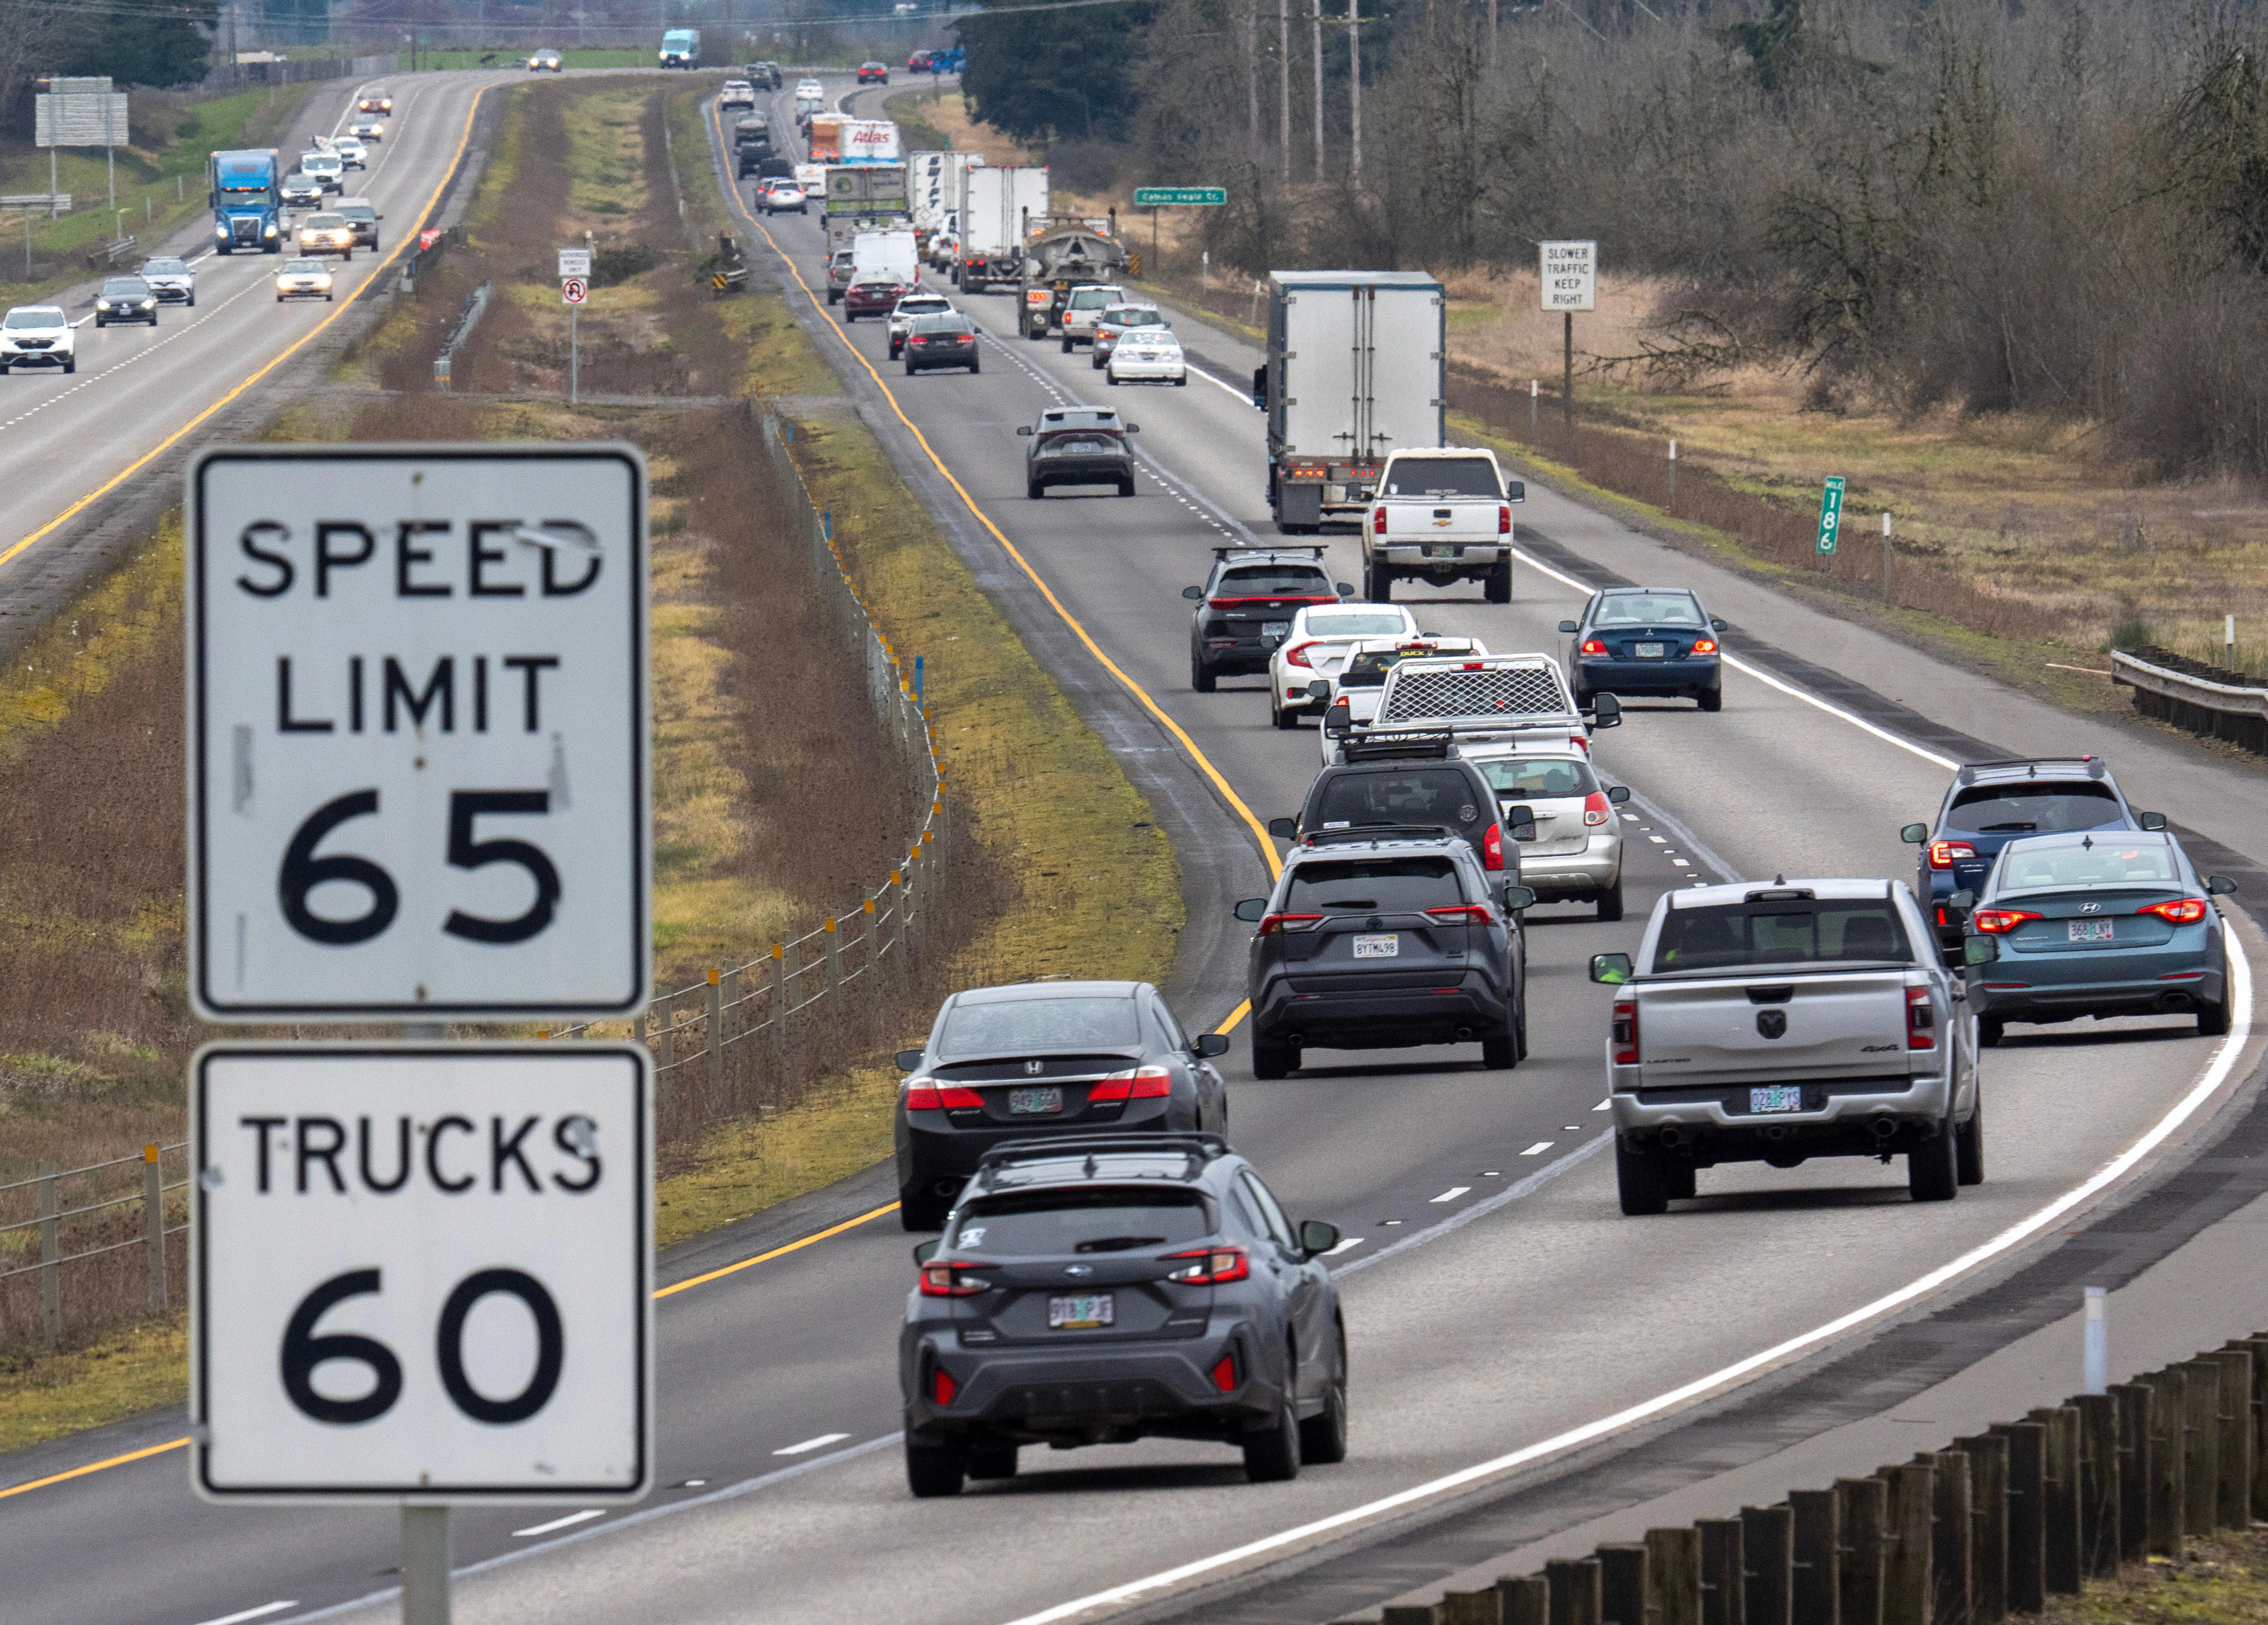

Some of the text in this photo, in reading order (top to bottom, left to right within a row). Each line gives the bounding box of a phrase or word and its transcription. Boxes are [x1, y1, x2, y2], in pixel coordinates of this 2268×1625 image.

[853, 130, 890, 143] Atlas
[1547, 248, 1588, 259] SLOWER
[1547, 263, 1589, 274] TRAFFIC
[1554, 278, 1581, 289] KEEP
[1552, 294, 1583, 305] RIGHT
[1826, 481, 1843, 490] MILE
[1820, 492, 1836, 549] 186
[238, 520, 602, 598] SPEED
[278, 656, 560, 733] LIMIT
[278, 789, 562, 946] 65
[2071, 924, 2088, 936] 368
[1356, 942, 1395, 955] 8YTM498
[242, 1116, 602, 1194] TRUCKS
[280, 1268, 564, 1425] 60
